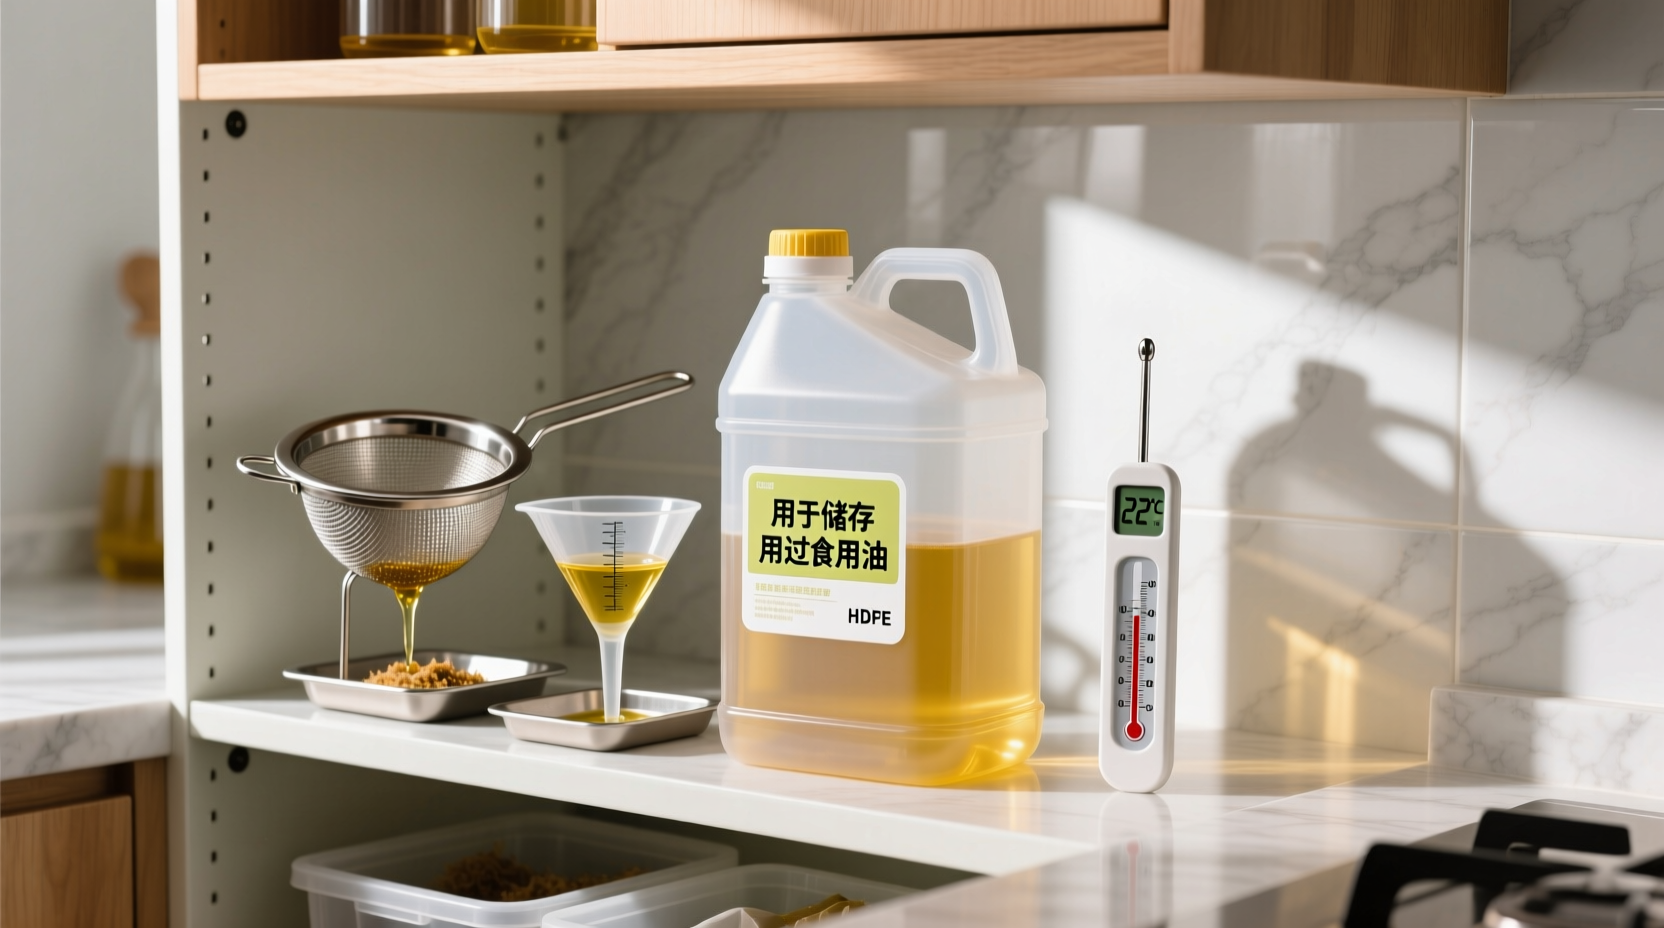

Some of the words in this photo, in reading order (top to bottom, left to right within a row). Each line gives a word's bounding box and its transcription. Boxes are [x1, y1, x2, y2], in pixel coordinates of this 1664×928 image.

[771, 498, 875, 532] 用于储存
[759, 534, 888, 571] 用过食用油
[848, 607, 892, 626] HDPE
